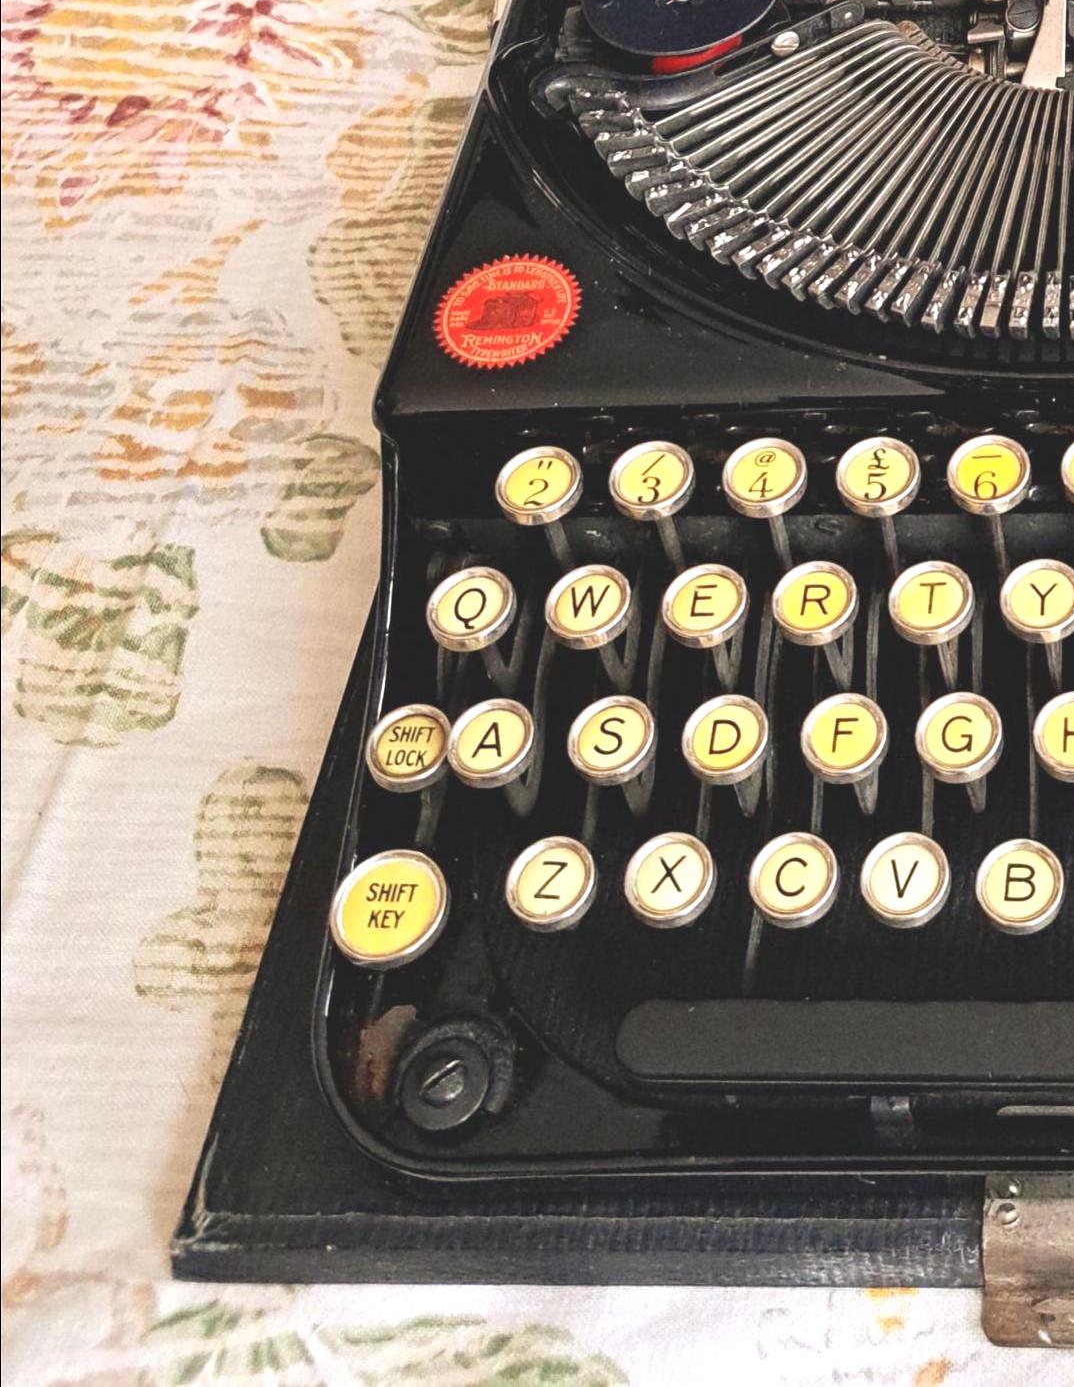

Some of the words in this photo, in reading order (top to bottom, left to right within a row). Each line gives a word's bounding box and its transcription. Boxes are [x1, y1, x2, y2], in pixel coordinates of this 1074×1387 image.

[461, 332, 543, 348] REMINGTON
[755, 448, 778, 466] @
[868, 447, 891, 470] £
[524, 478, 550, 507] 2
[636, 475, 661, 505] 3
[747, 471, 774, 499] 4
[864, 472, 888, 502] 5
[972, 472, 999, 501] 6
[454, 587, 487, 630] Q
[571, 584, 609, 621] W
[690, 584, 718, 618] E
[800, 584, 831, 616] R
[919, 581, 947, 615] T
[1030, 583, 1058, 616] Y
[387, 723, 437, 744] SHIFT
[471, 721, 502, 759] A
[593, 717, 625, 756] S
[708, 719, 742, 755] D
[831, 717, 859, 753] F
[941, 715, 973, 753] G
[384, 749, 428, 769] LOCK
[533, 860, 568, 900] Z
[651, 855, 686, 894] X
[775, 857, 808, 898] C
[890, 859, 919, 899] V
[1003, 863, 1036, 902] B
[366, 882, 419, 903] SHIFT
[367, 909, 405, 929] KEY
